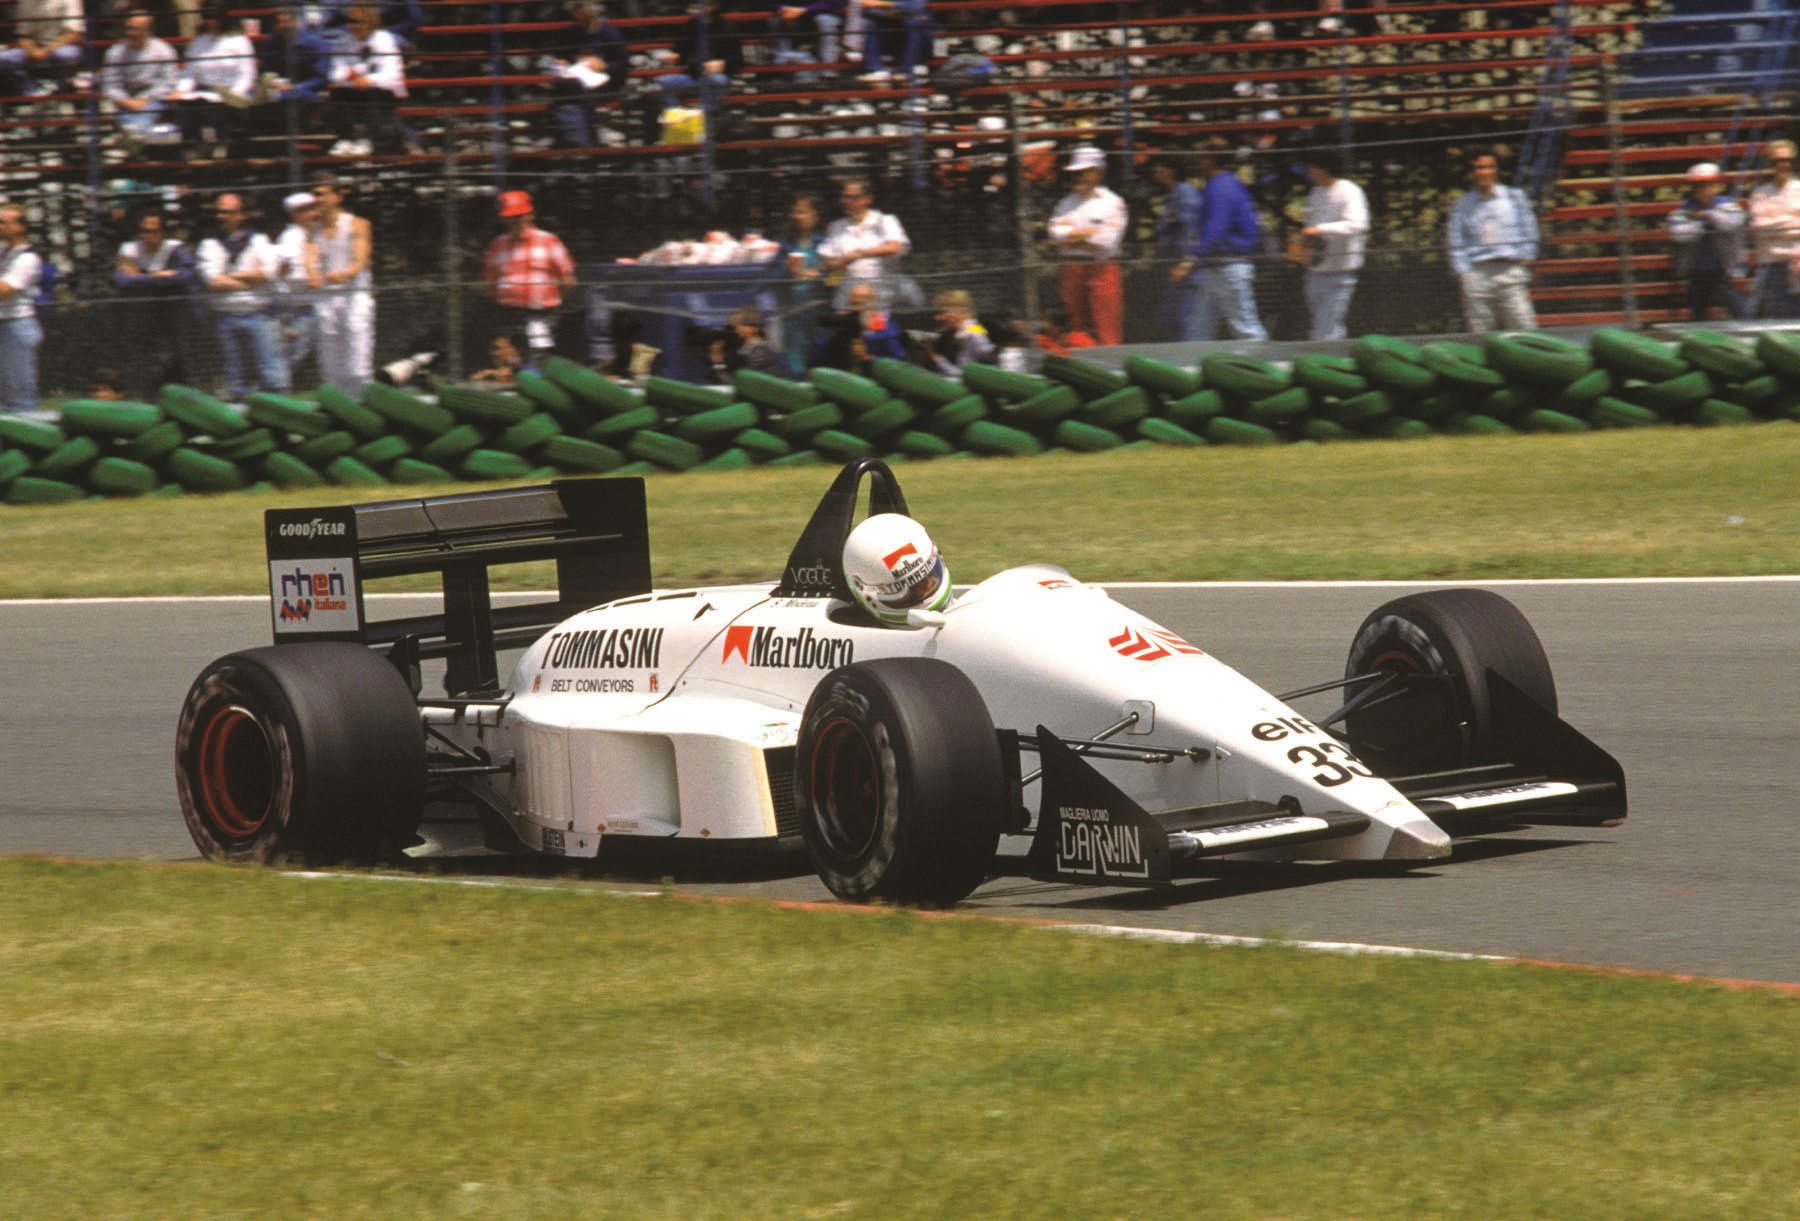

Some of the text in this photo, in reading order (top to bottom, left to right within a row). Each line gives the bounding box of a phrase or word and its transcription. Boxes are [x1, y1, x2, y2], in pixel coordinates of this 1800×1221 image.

[280, 519, 346, 538] GOODYEAR
[891, 556, 924, 579] Marlboro
[541, 627, 664, 670] TOMMASINI
[749, 626, 854, 670] Marlboro
[551, 679, 571, 692] BELT
[575, 679, 634, 693] CONVEYORS
[1287, 742, 1373, 787] 33
[1060, 821, 1143, 873] DARWIN
